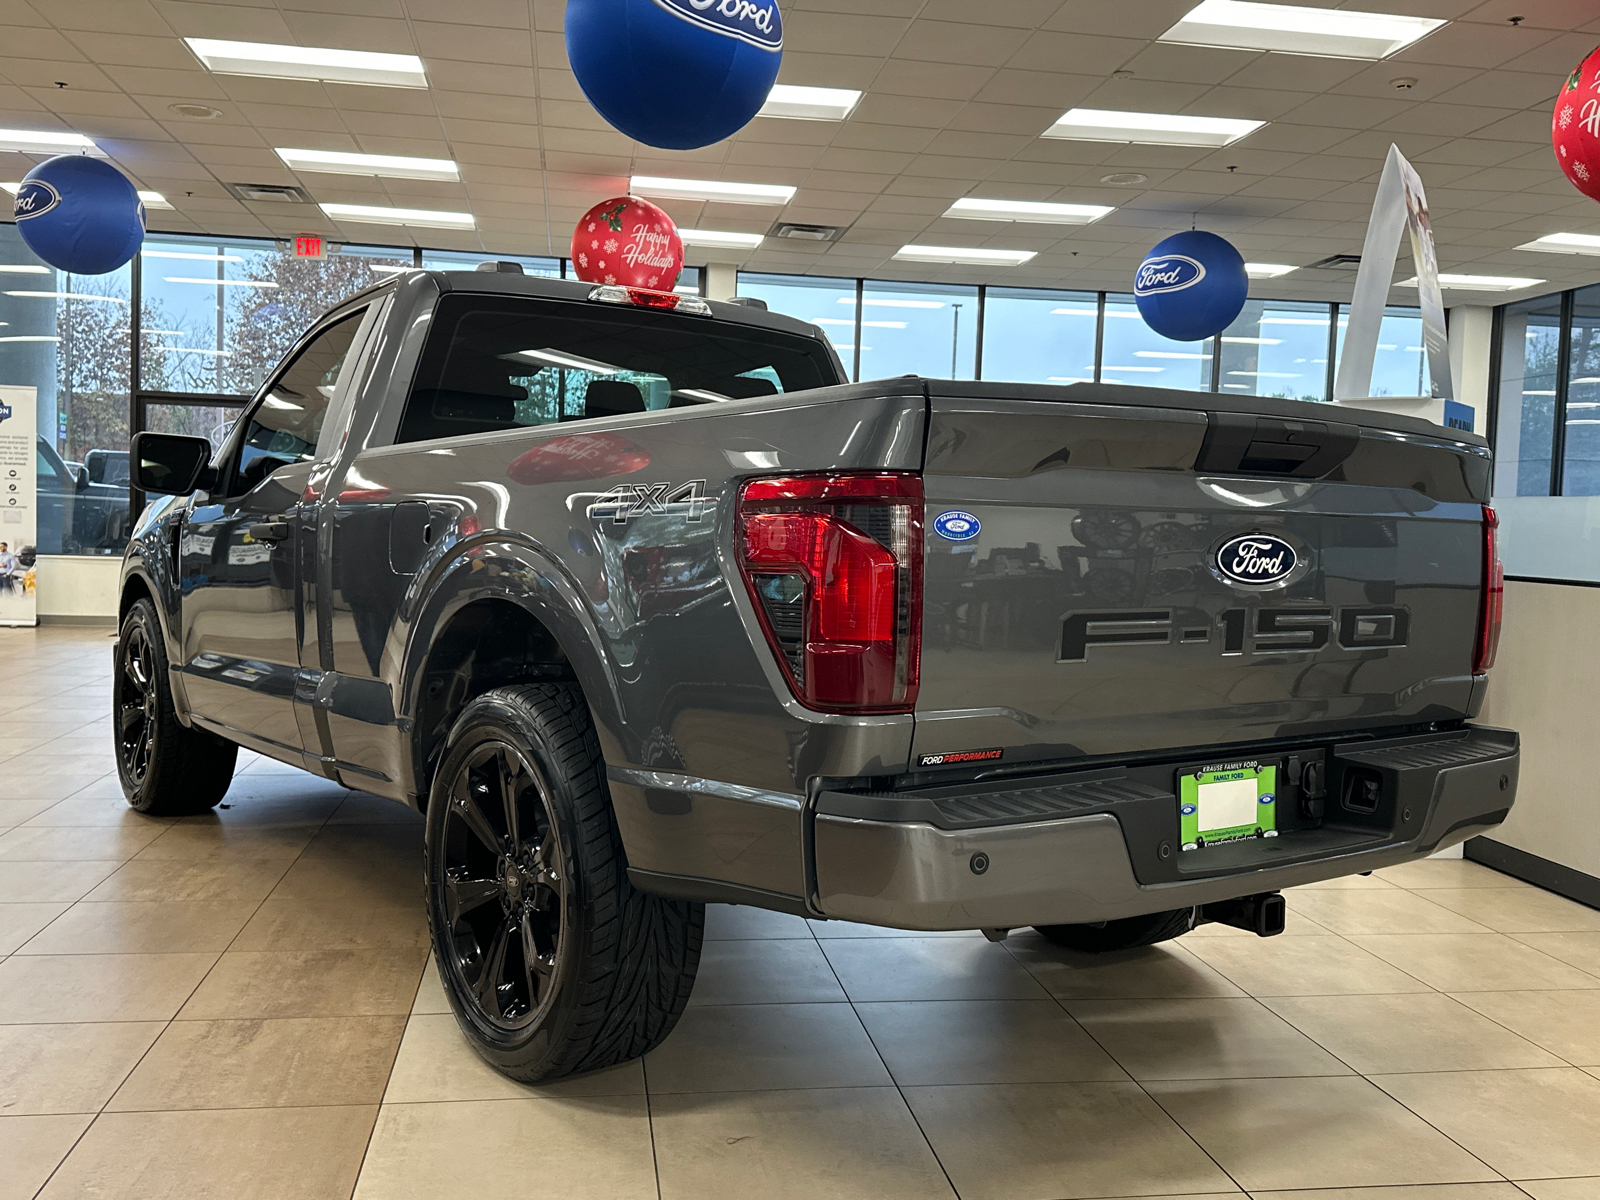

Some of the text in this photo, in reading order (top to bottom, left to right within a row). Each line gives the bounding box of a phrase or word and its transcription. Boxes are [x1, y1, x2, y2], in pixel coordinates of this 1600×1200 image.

[689, 0, 774, 34] ord
[296, 237, 322, 257] EXIT
[631, 223, 671, 252] Happy
[621, 243, 675, 275] Holidays
[1138, 262, 1182, 289] Ford
[950, 521, 965, 530] Ford
[1232, 541, 1284, 574] Ford
[1056, 604, 1412, 663] F-150
[921, 749, 1002, 766] FORD PERFORMANCE
[1202, 760, 1258, 773] KRAUSE FAMILY FORD
[1213, 772, 1244, 782] FAMILY FORD
